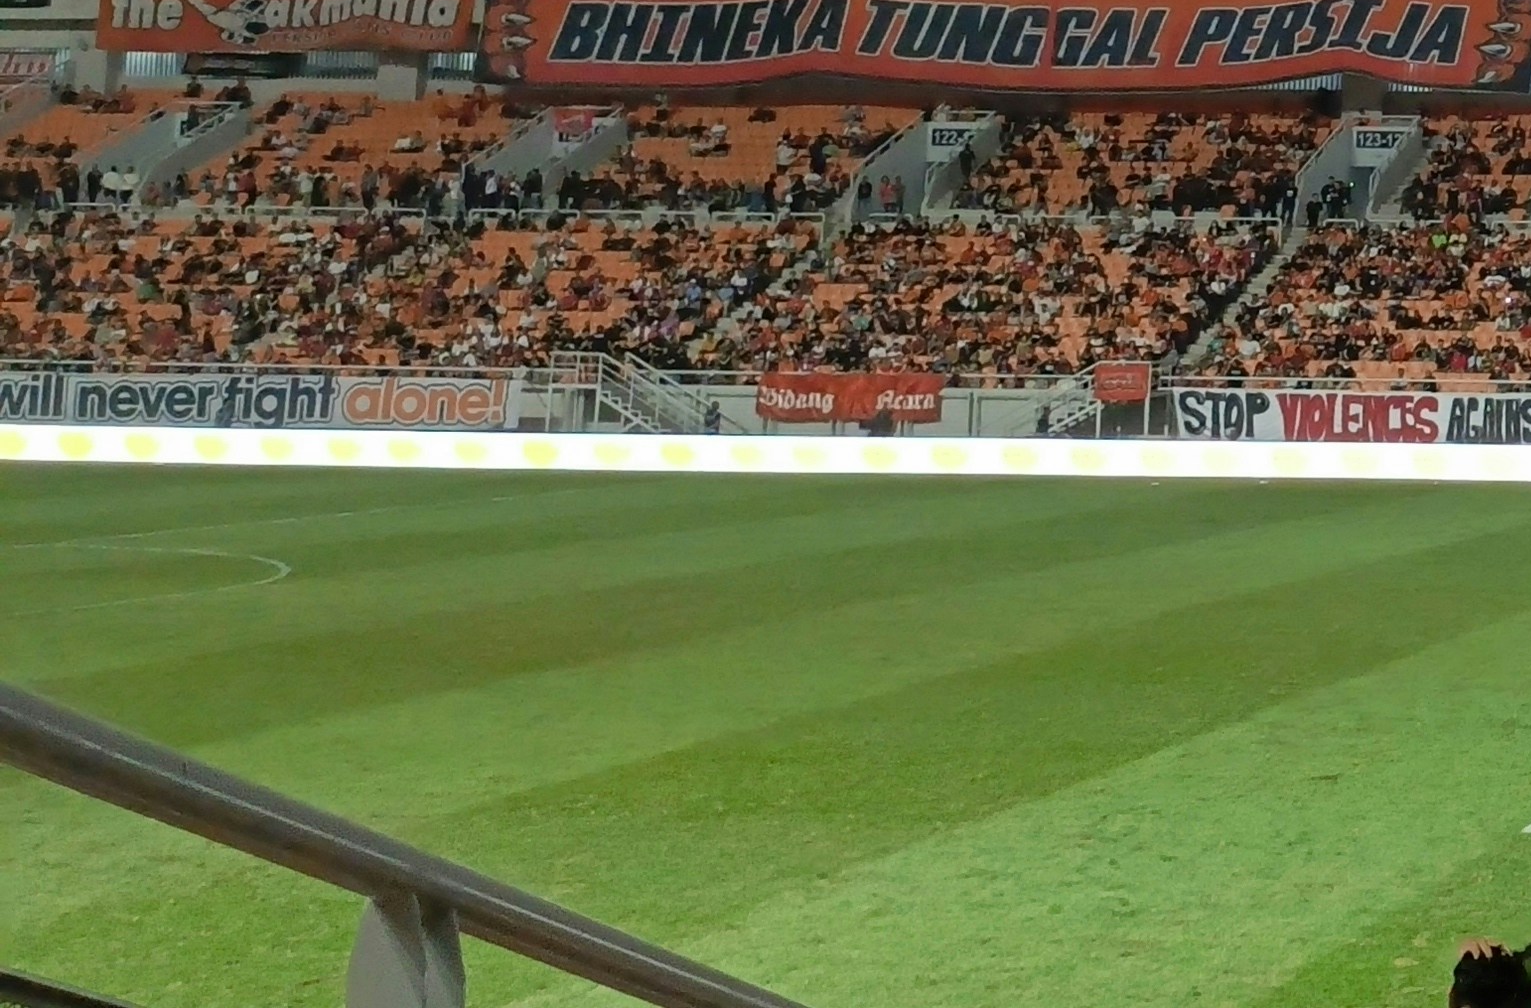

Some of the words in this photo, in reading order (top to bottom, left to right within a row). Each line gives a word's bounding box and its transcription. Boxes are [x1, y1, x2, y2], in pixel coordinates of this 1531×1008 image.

[78, 381, 215, 419] never
[222, 376, 338, 429] fight
[345, 378, 506, 426] alone!
[1179, 390, 1270, 439] STOP
[1276, 393, 1439, 442] VIOLENCES
